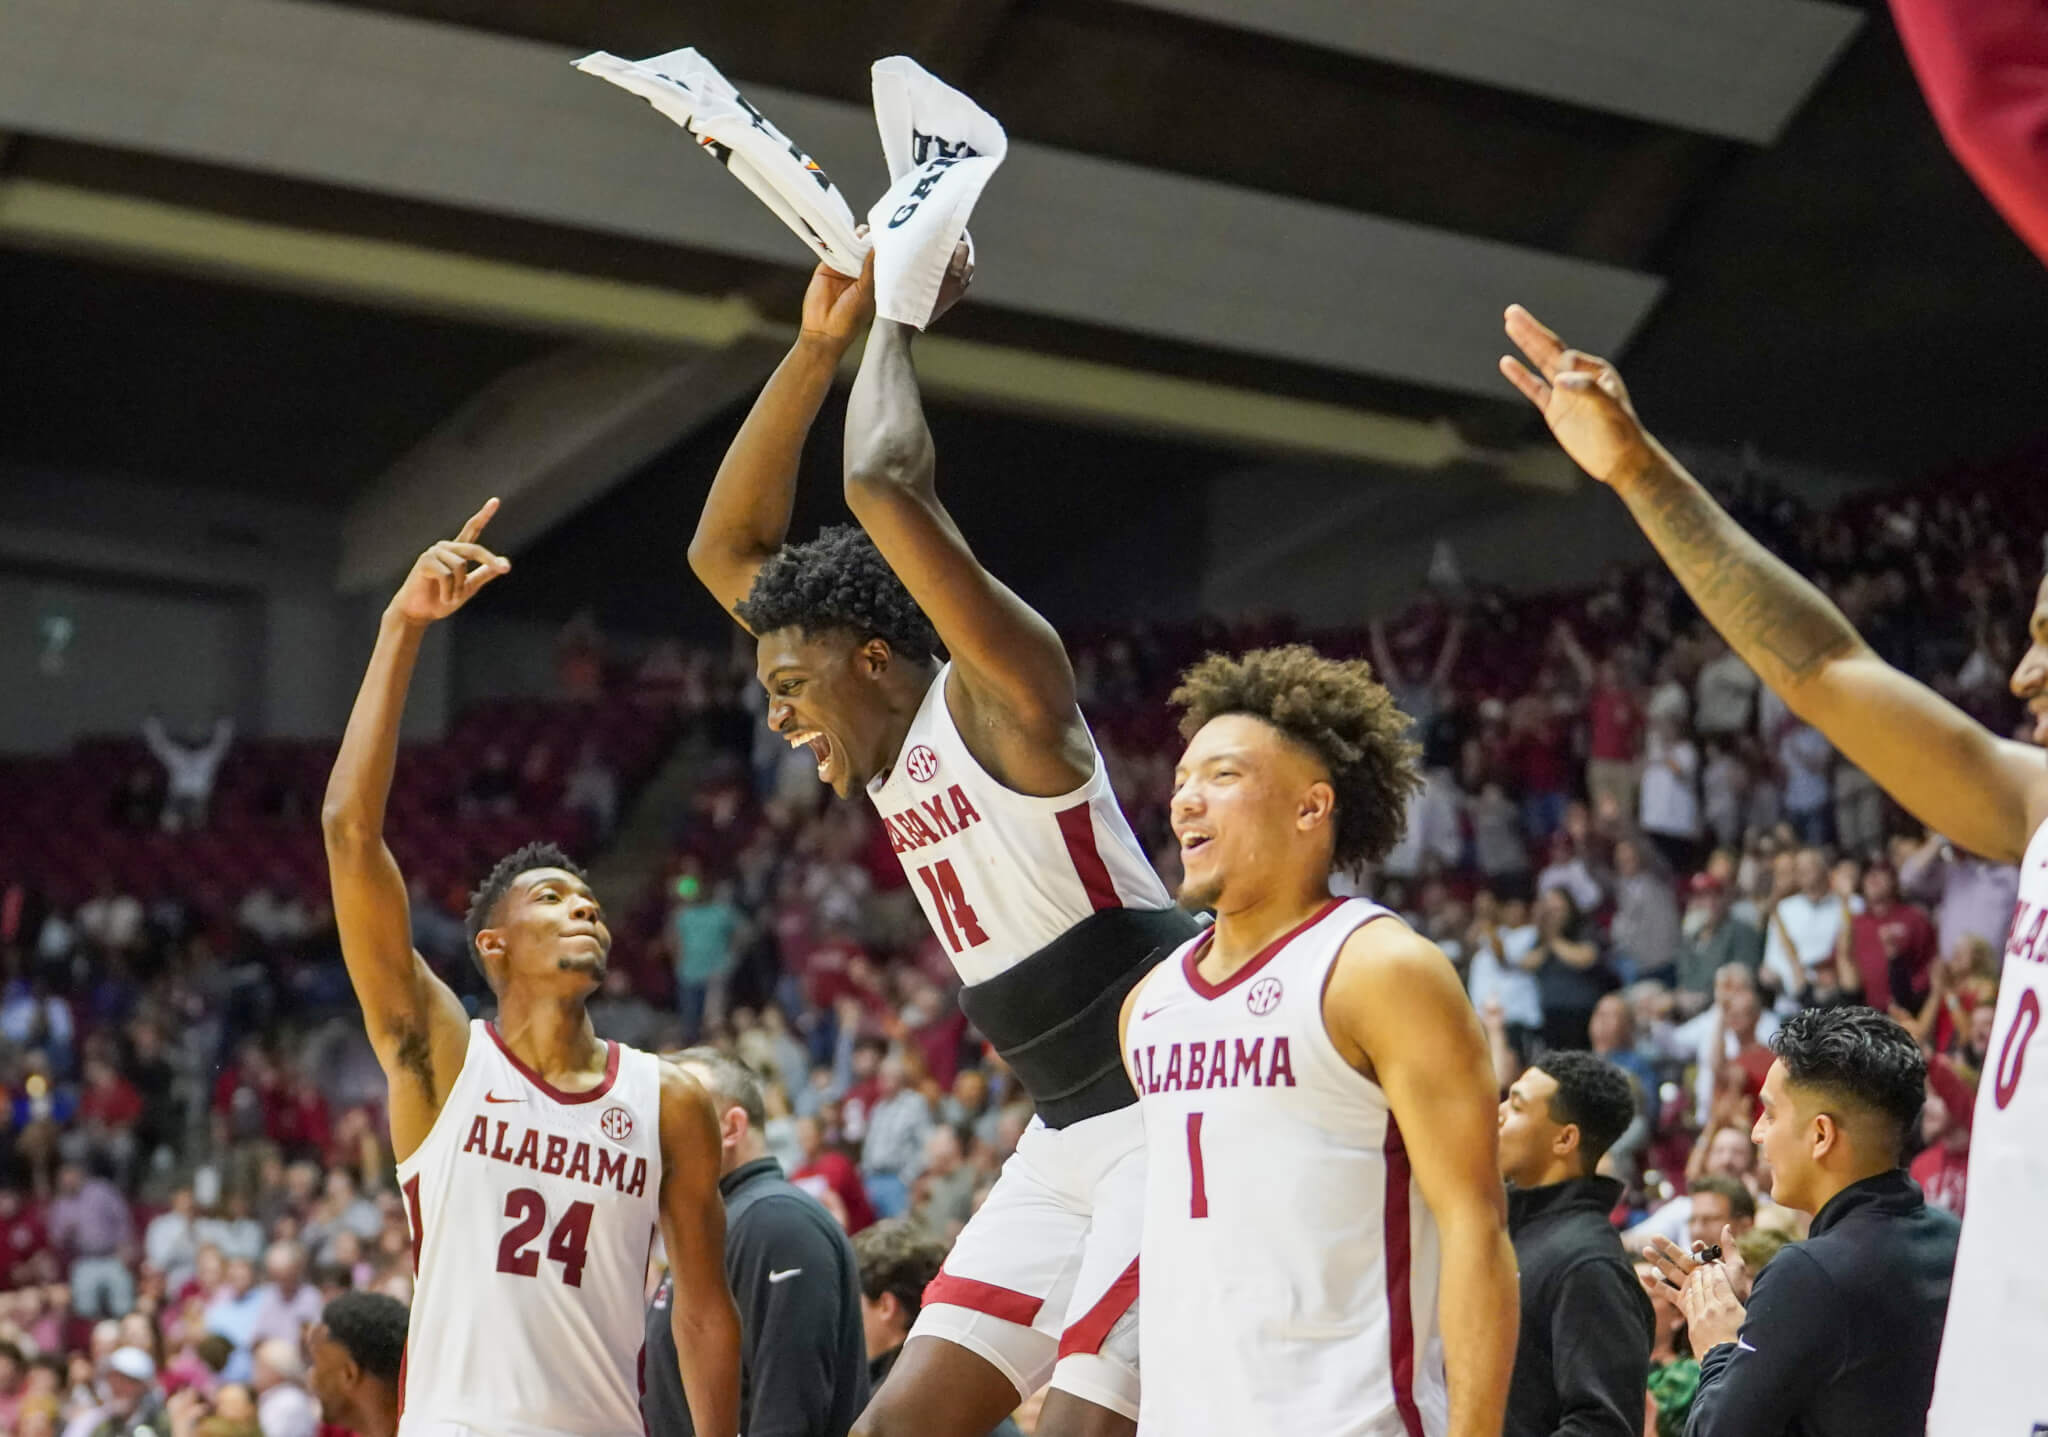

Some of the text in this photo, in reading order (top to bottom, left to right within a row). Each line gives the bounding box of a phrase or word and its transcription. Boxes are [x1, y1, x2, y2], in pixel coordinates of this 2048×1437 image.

[906, 745, 938, 783] SEC
[917, 858, 990, 954] 14
[1247, 977, 1283, 1017] SEC
[1133, 1036, 1297, 1097] ALABAMA
[1995, 987, 2040, 1111] 0
[463, 1114, 647, 1198] ALABAMA
[601, 1107, 633, 1141] SEC
[1186, 1112, 1209, 1219] 1
[496, 1188, 595, 1289] 24
